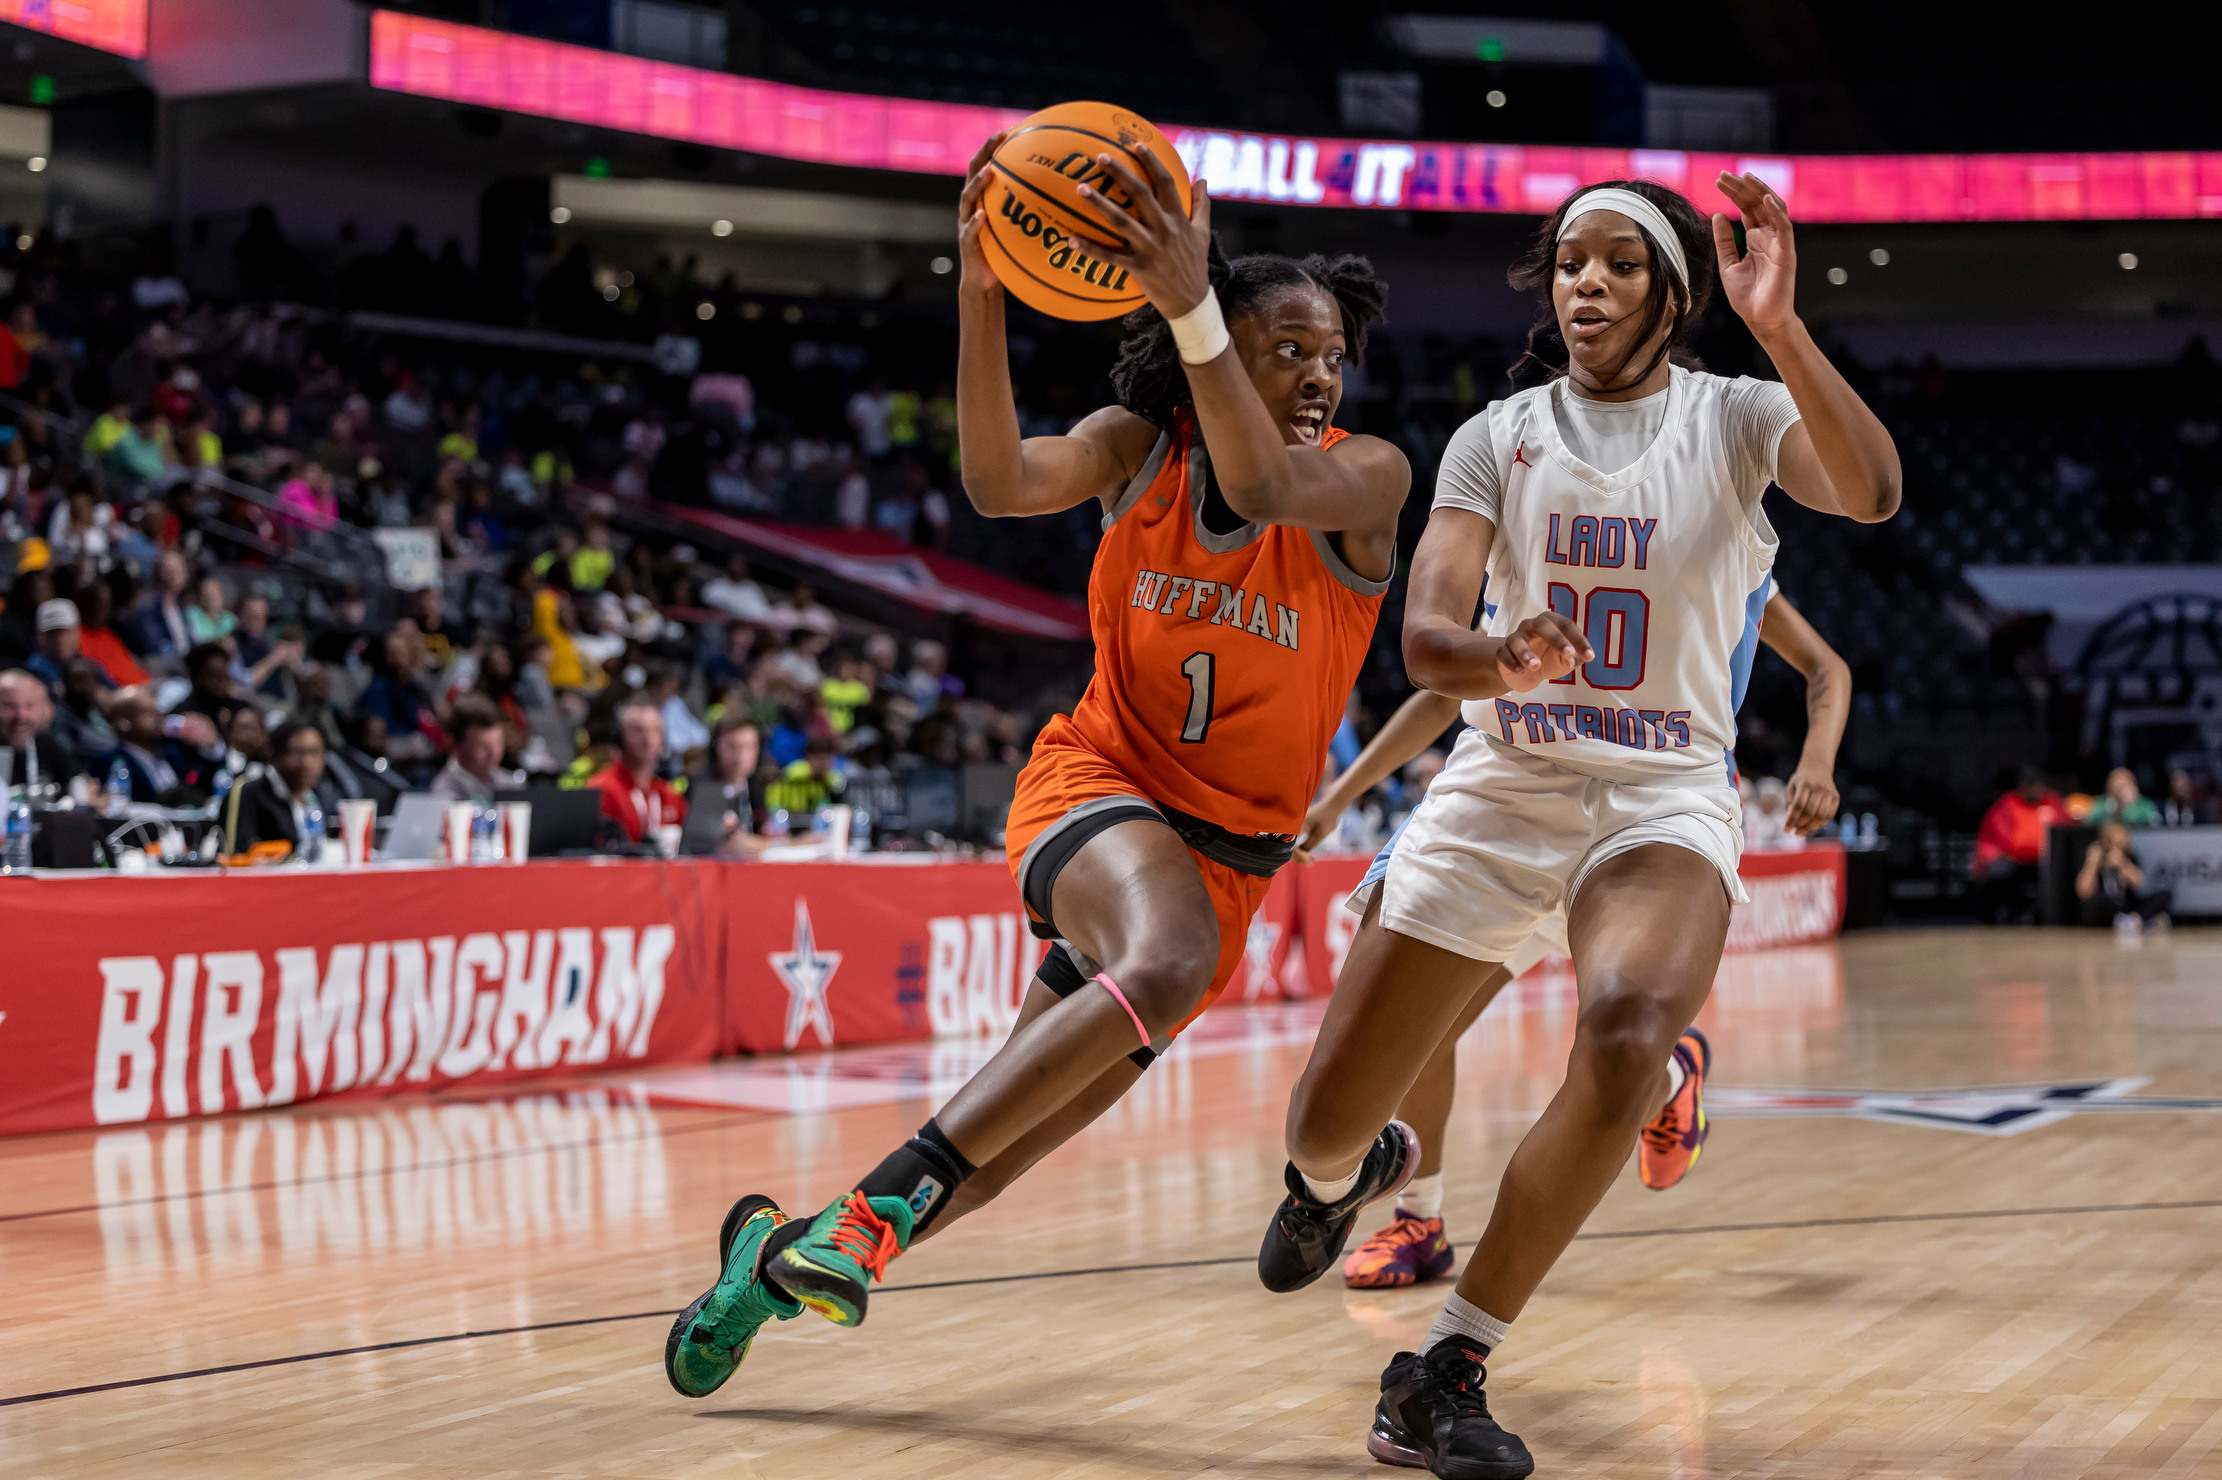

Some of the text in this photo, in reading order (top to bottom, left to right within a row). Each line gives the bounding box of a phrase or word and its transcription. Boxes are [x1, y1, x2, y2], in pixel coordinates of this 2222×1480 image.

[1025, 153, 1057, 169] NXT
[1001, 190, 1131, 292] Wilson
[1545, 513, 1658, 570] LADY
[1131, 569, 1299, 652] HUFFMAN
[1180, 651, 1216, 744] 1
[1494, 698, 1692, 750] PATRIOTS
[92, 924, 675, 1126] BIRMINGHAM
